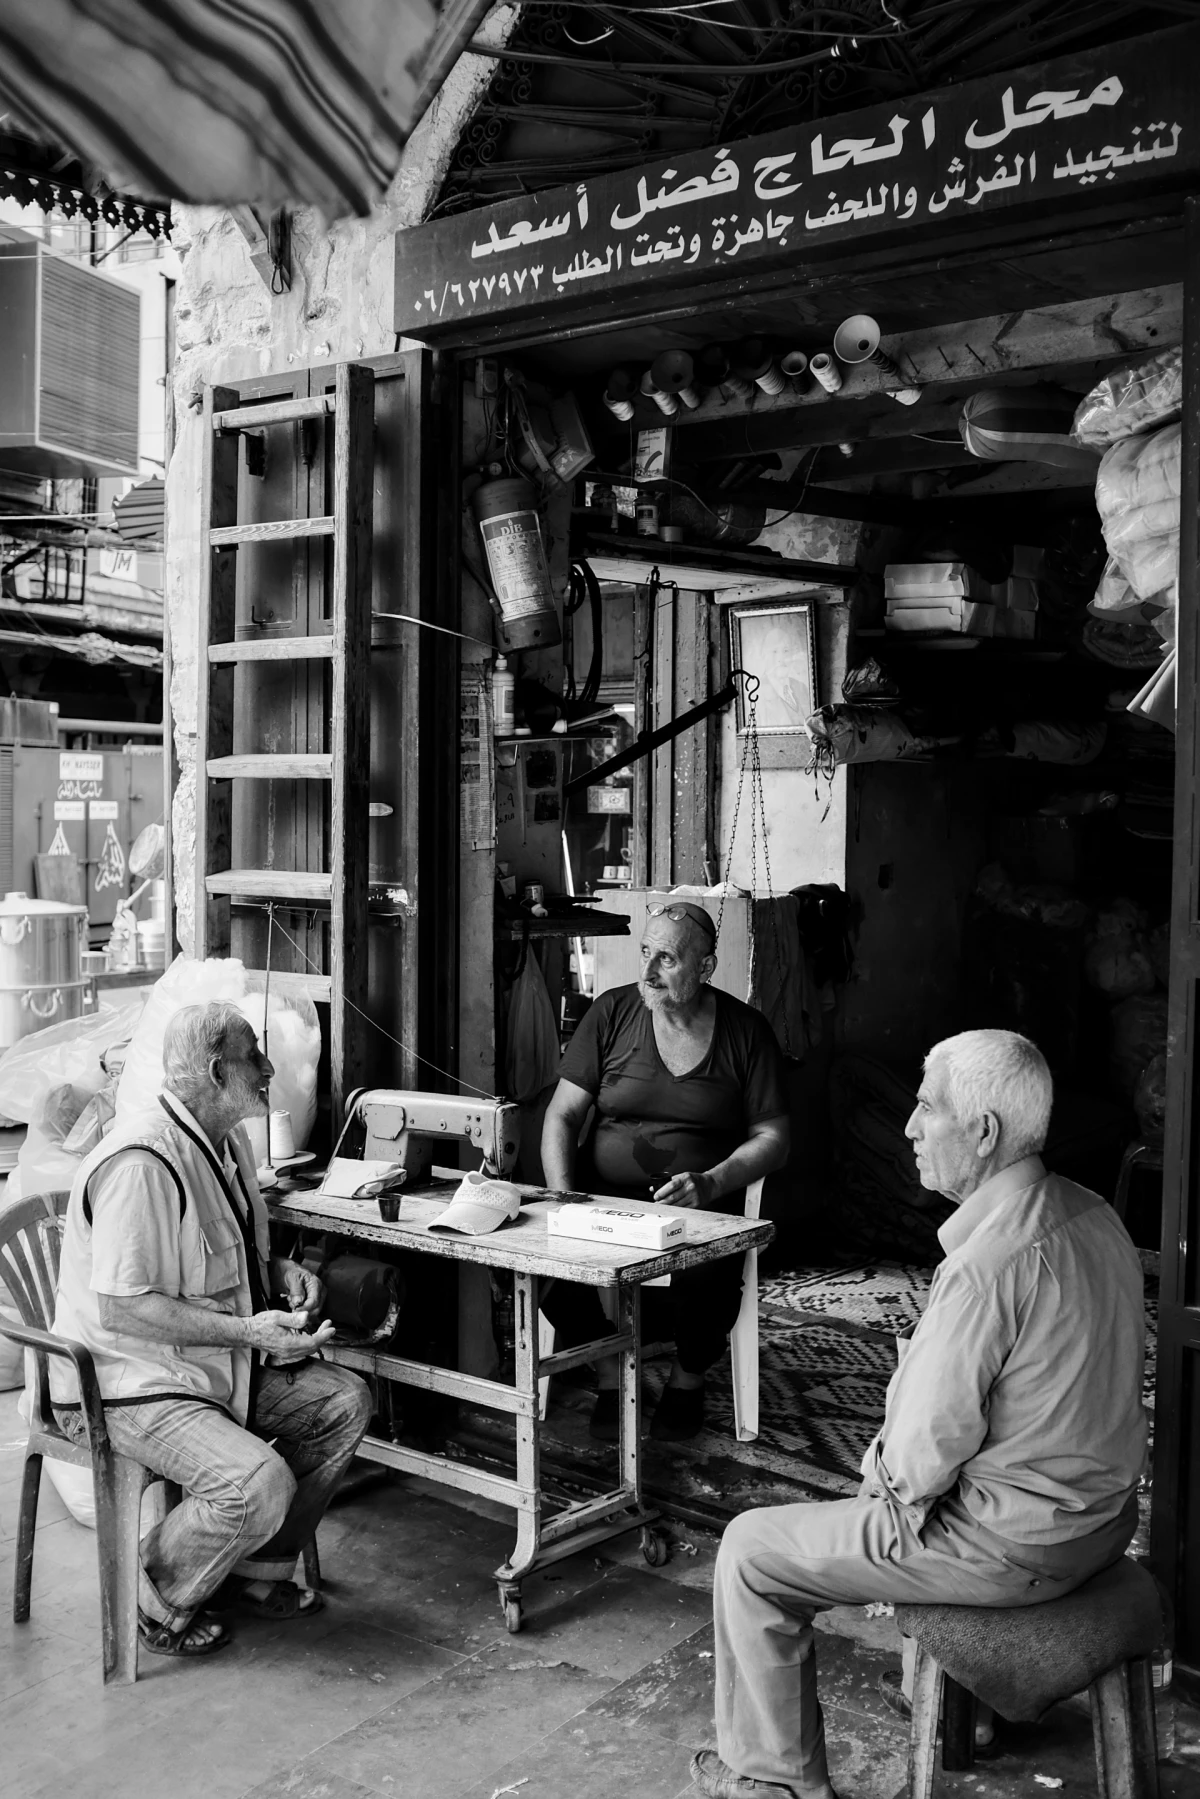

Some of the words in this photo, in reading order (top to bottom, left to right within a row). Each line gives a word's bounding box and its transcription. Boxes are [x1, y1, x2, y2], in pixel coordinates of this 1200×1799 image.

[965, 76, 1124, 149] محل
[753, 106, 936, 200] الحاج
[928, 151, 1036, 214] الفرش
[1053, 122, 1182, 186] لتنجيد
[610, 147, 740, 230] فضل
[804, 183, 918, 230] واللحف
[470, 183, 589, 259] أسعد
[630, 226, 701, 264] وتحت
[711, 209, 795, 256] جاهزة
[551, 243, 622, 293] الطلب
